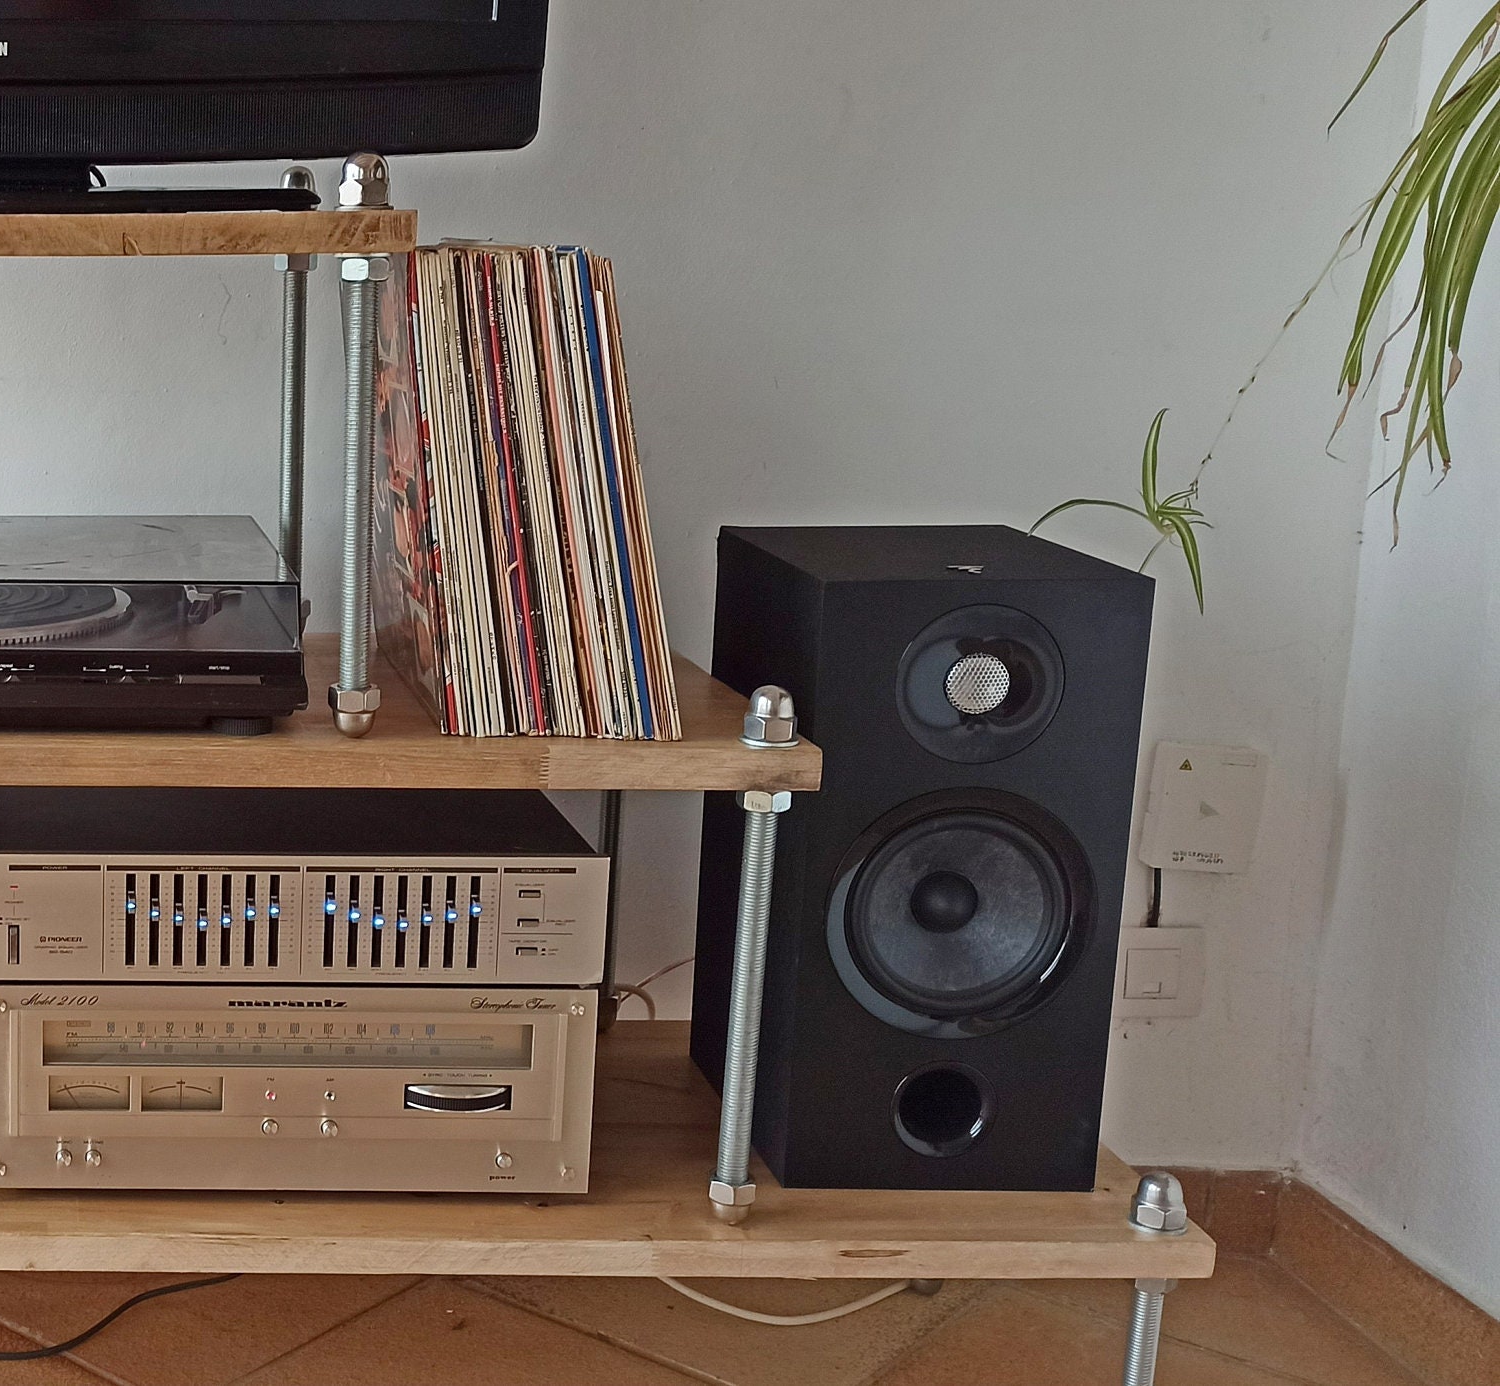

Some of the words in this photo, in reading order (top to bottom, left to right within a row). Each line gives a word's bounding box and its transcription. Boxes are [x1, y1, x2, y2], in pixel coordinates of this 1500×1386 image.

[20, 992, 57, 1006] Model
[57, 995, 99, 1006] 2100
[228, 999, 347, 1008] marantz
[165, 1022, 174, 1033] 92
[195, 1022, 204, 1034] 94
[226, 1023, 235, 1034] 96
[258, 1023, 267, 1034] 98
[289, 1023, 300, 1034] 100
[323, 1023, 334, 1034] 102
[356, 1024, 367, 1035] 104
